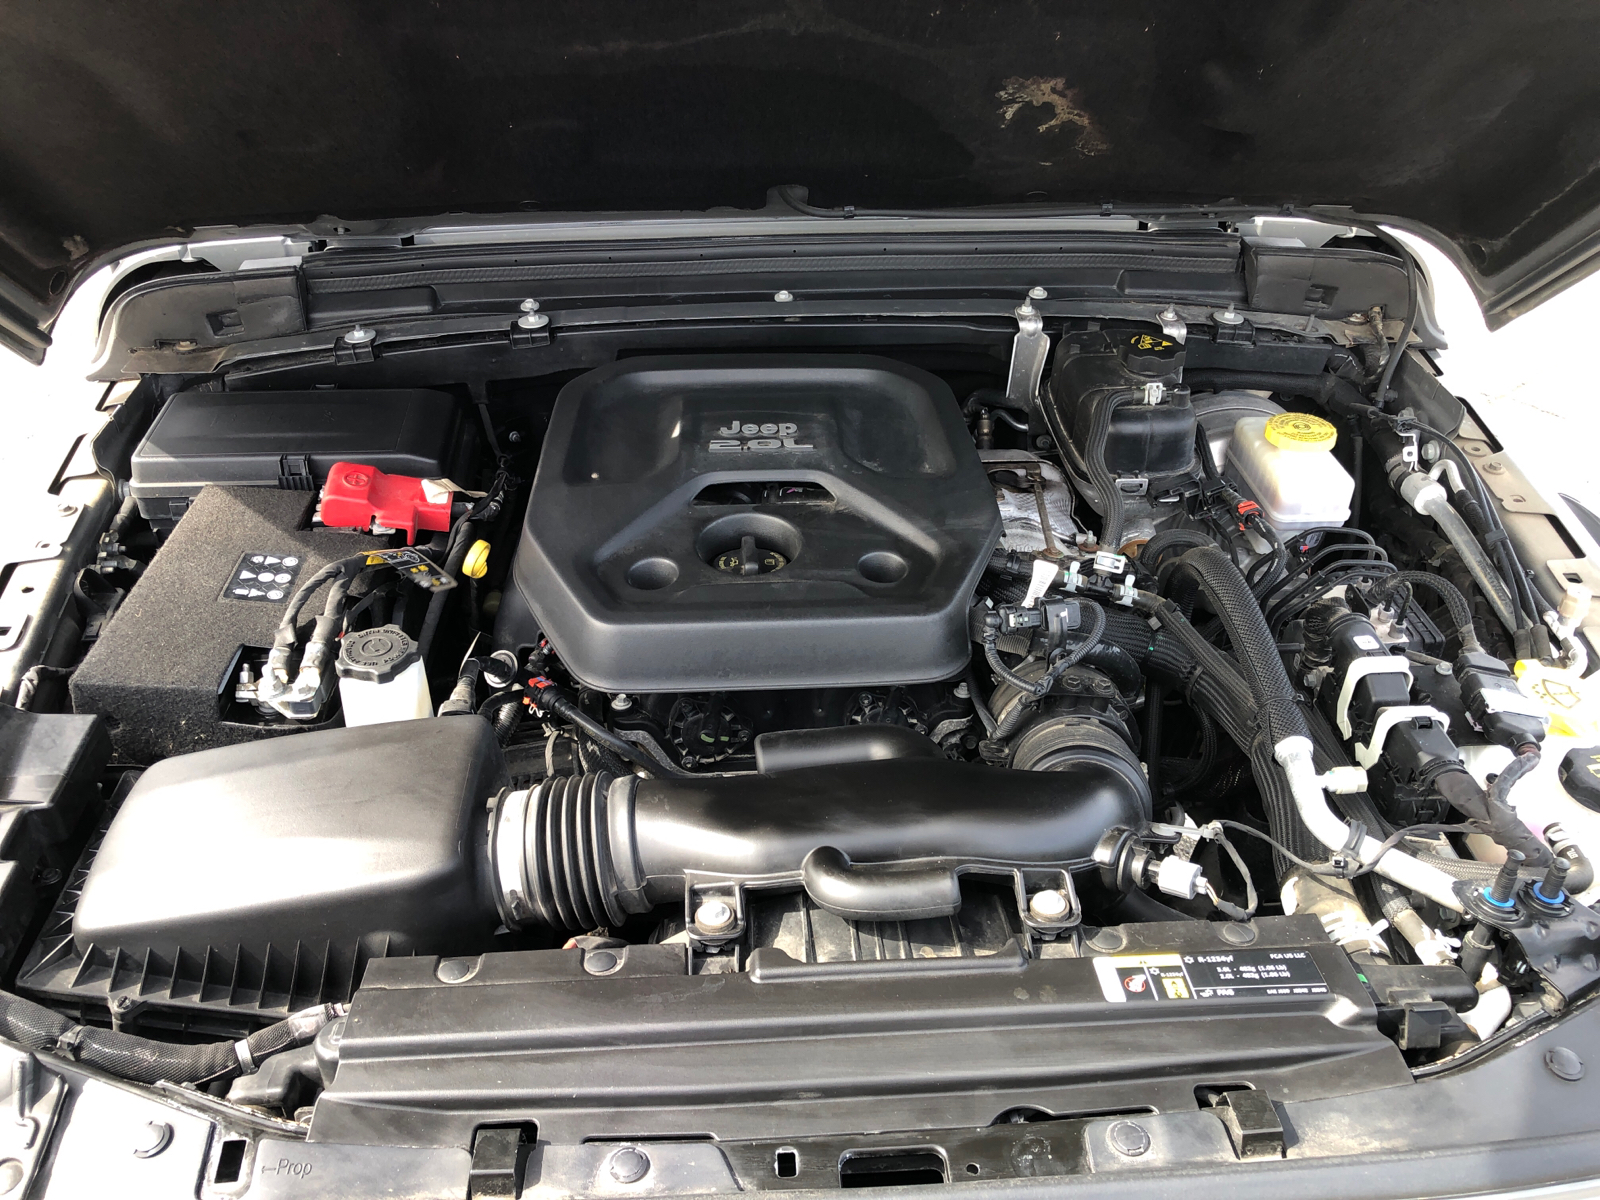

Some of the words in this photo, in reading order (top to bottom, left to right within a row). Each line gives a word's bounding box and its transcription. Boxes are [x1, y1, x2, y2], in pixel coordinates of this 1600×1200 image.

[720, 420, 798, 437] Jeep
[708, 438, 814, 452] 2.0L
[1197, 955, 1234, 963] R-1234yf
[276, 1158, 313, 1179] Prop
